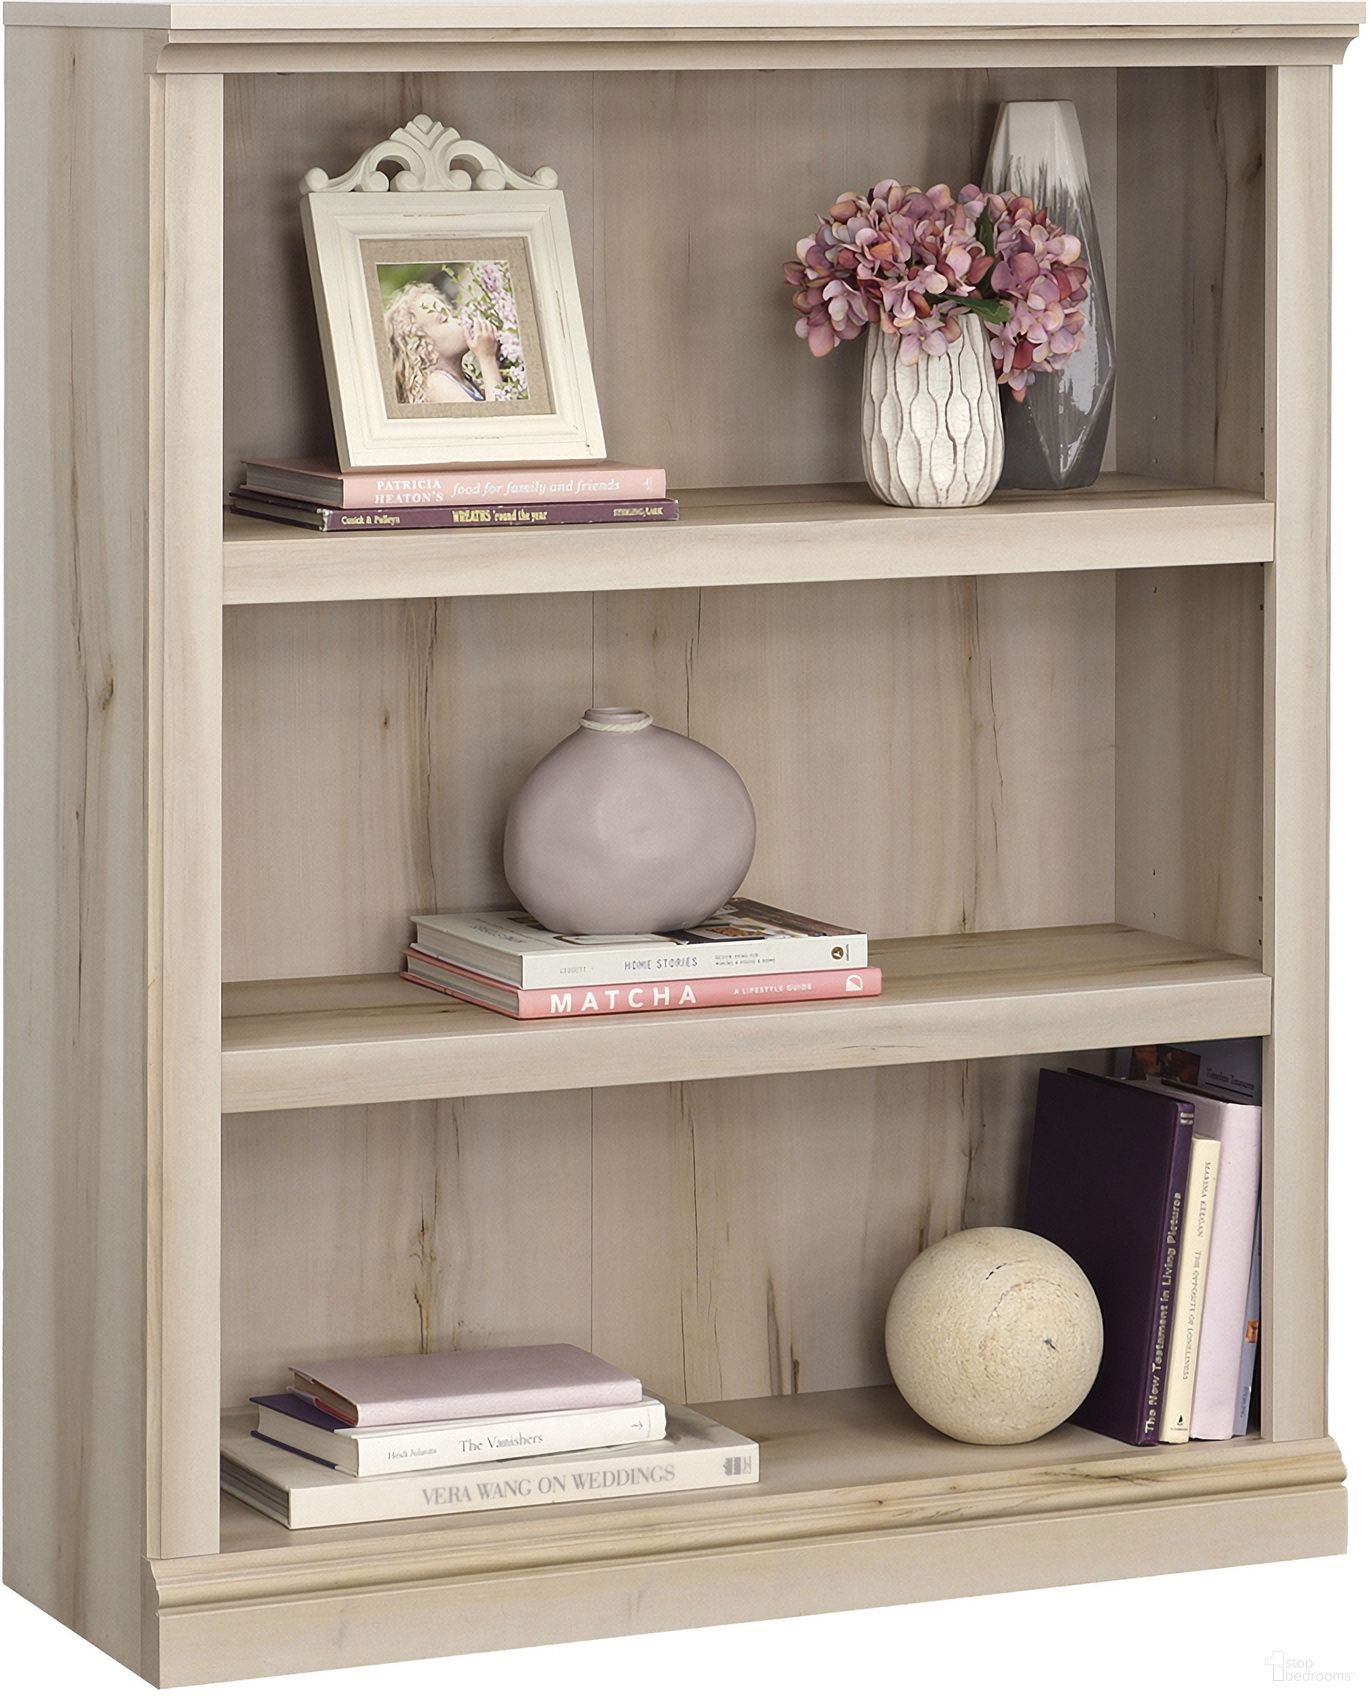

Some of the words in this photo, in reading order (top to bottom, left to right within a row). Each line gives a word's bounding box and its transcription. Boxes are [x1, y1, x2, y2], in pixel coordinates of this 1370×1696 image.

[376, 479, 442, 491] PATRICIA
[450, 482, 480, 498] food
[482, 481, 503, 497] for
[503, 480, 546, 496] family
[549, 479, 573, 492] and
[575, 478, 620, 494] friends
[375, 491, 444, 504] HEATON'S
[624, 958, 652, 972] HOME
[656, 956, 698, 970] STORIES
[550, 984, 697, 1014] MATCHA
[742, 984, 784, 995] LIFESTYLE
[786, 983, 812, 992] GUIDE
[1162, 1247, 1176, 1286] Living
[1160, 1289, 1170, 1302] in
[1145, 1409, 1157, 1434] The
[458, 1438, 484, 1453] The
[487, 1432, 544, 1450] Vanishers
[422, 1485, 473, 1506] VERA
[476, 1478, 532, 1501] WANG
[538, 1474, 567, 1495] ON
[571, 1463, 676, 1491] WEDDINGS
